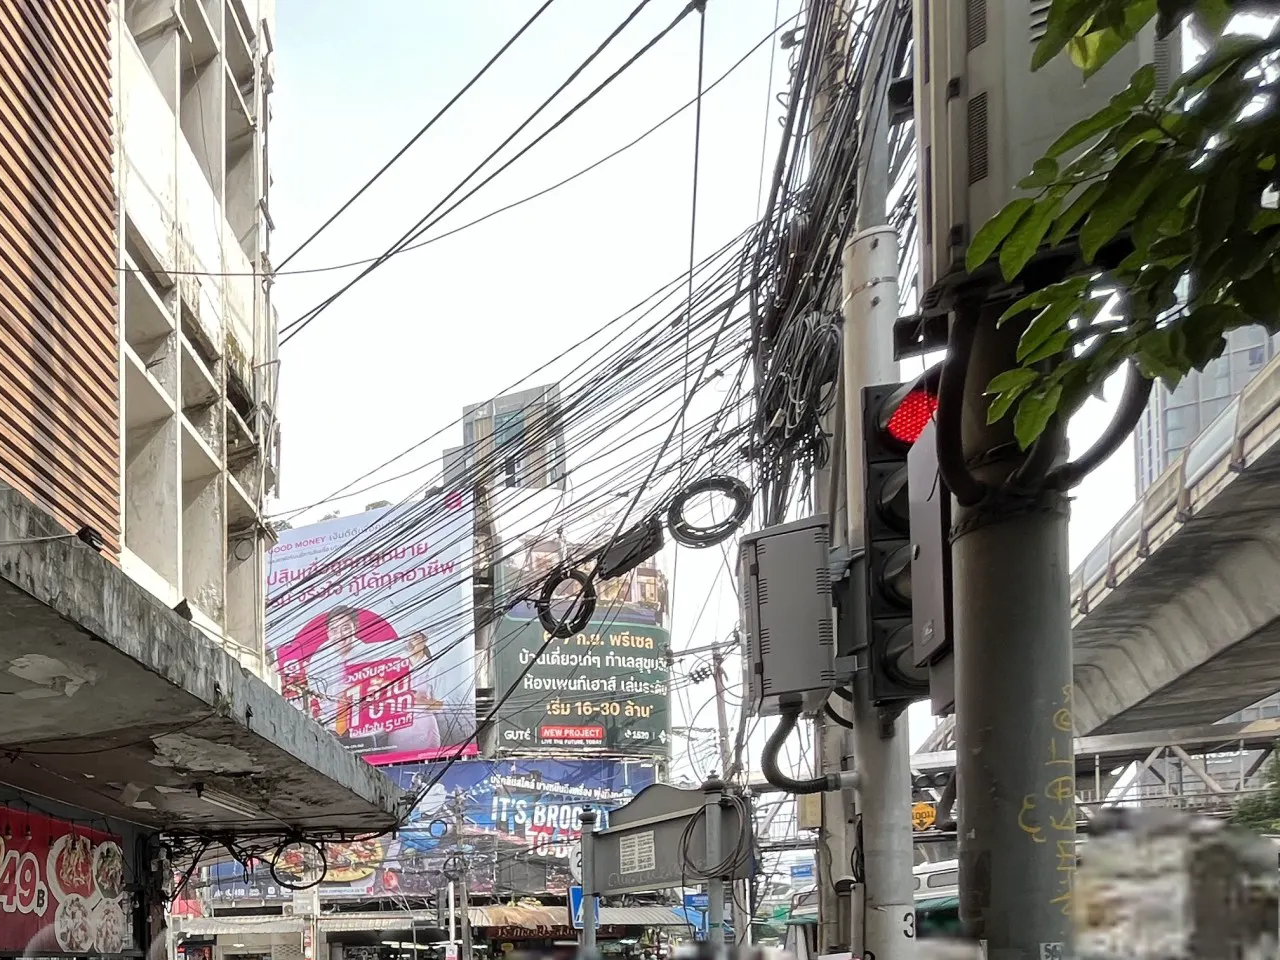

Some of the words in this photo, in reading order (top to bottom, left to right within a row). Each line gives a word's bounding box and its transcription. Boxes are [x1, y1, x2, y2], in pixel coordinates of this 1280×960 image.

[294, 535, 326, 549] MONEY
[347, 684, 361, 728] 1
[368, 694, 413, 719] บาท
[574, 701, 621, 716] 16-30
[385, 719, 394, 732] 5
[543, 728, 563, 737] NEW
[564, 728, 600, 737] PROJECT
[503, 728, 531, 741] GUTÉ
[491, 796, 527, 825] IT'S
